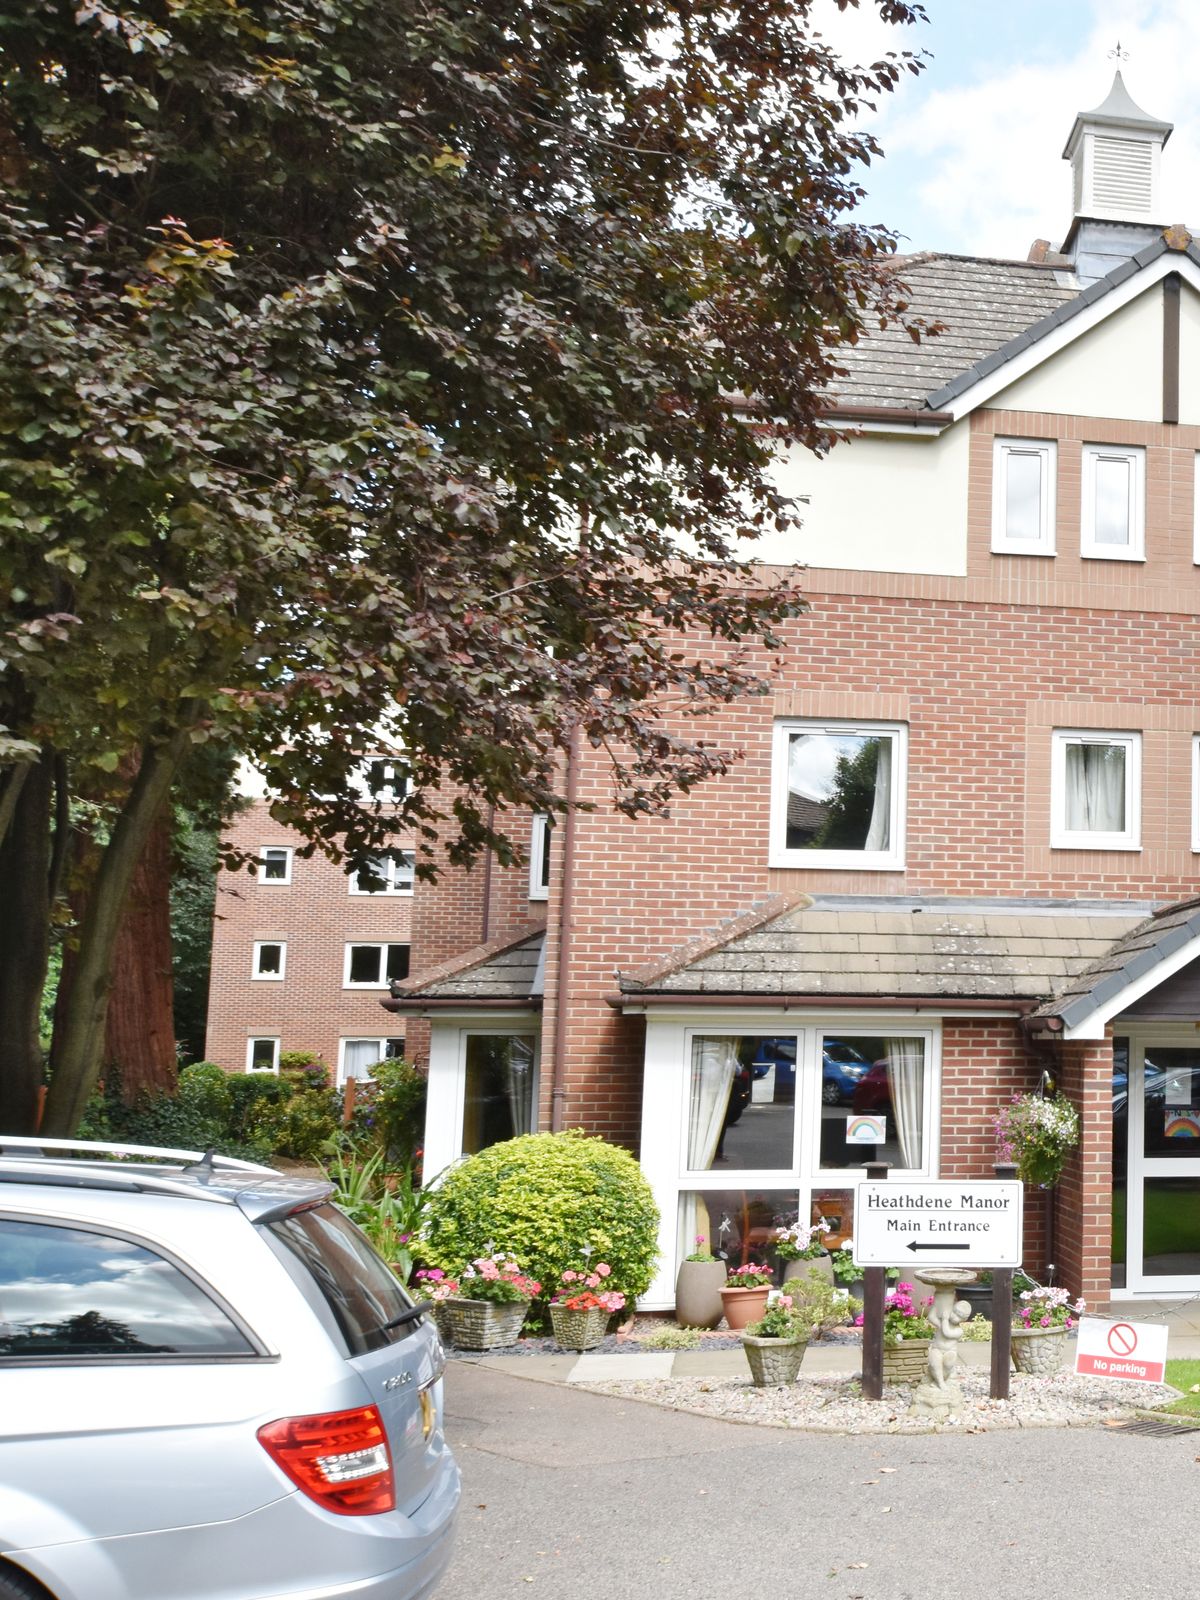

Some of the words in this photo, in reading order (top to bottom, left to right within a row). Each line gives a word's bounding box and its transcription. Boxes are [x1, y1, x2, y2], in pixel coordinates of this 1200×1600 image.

[867, 1194, 953, 1208] Heathdene
[961, 1195, 1010, 1208] Manor
[887, 1219, 921, 1232] Main
[929, 1219, 990, 1232] Entrance
[1093, 1360, 1107, 1370] No
[1109, 1363, 1146, 1376] parking
